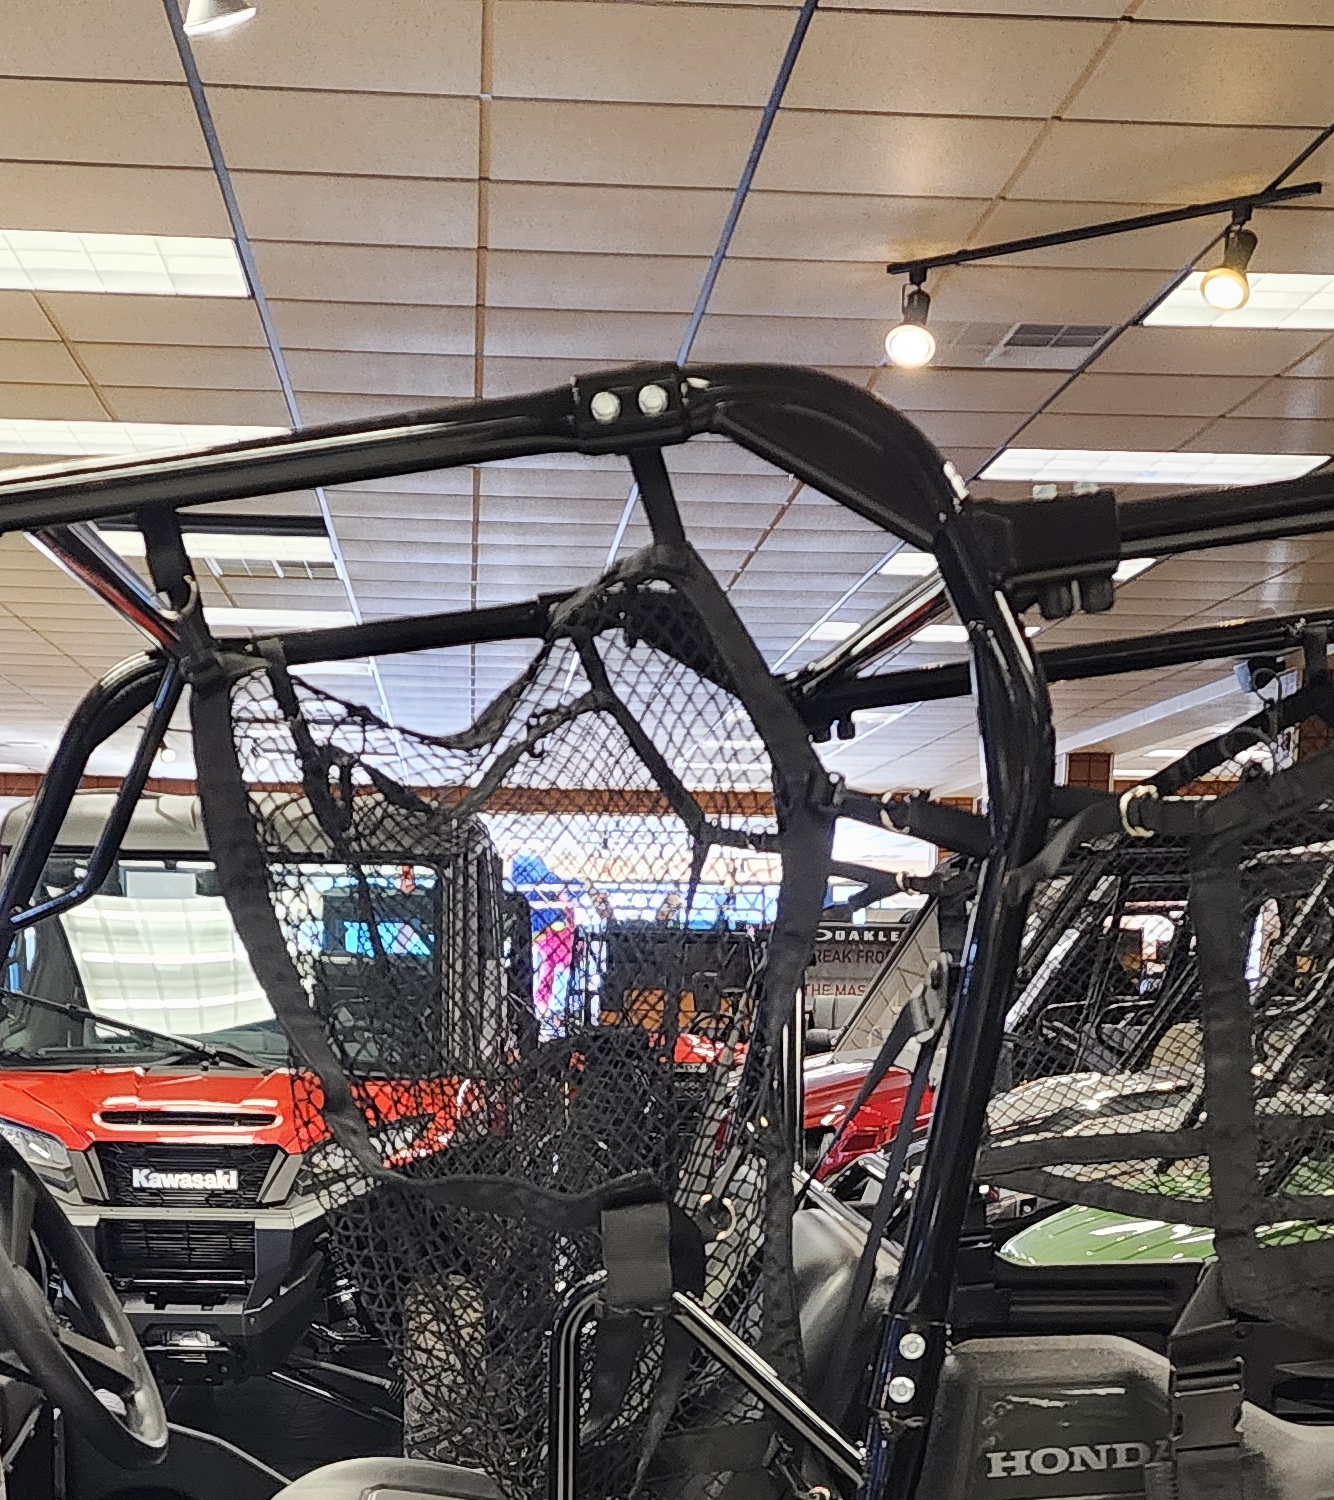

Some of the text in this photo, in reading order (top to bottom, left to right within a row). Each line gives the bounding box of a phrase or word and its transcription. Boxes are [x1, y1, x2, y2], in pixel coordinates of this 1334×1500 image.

[834, 930, 900, 942] OAKLE
[816, 949, 889, 965] REAK FRO
[835, 983, 866, 996] MAS
[132, 1168, 239, 1190] Kawasaki
